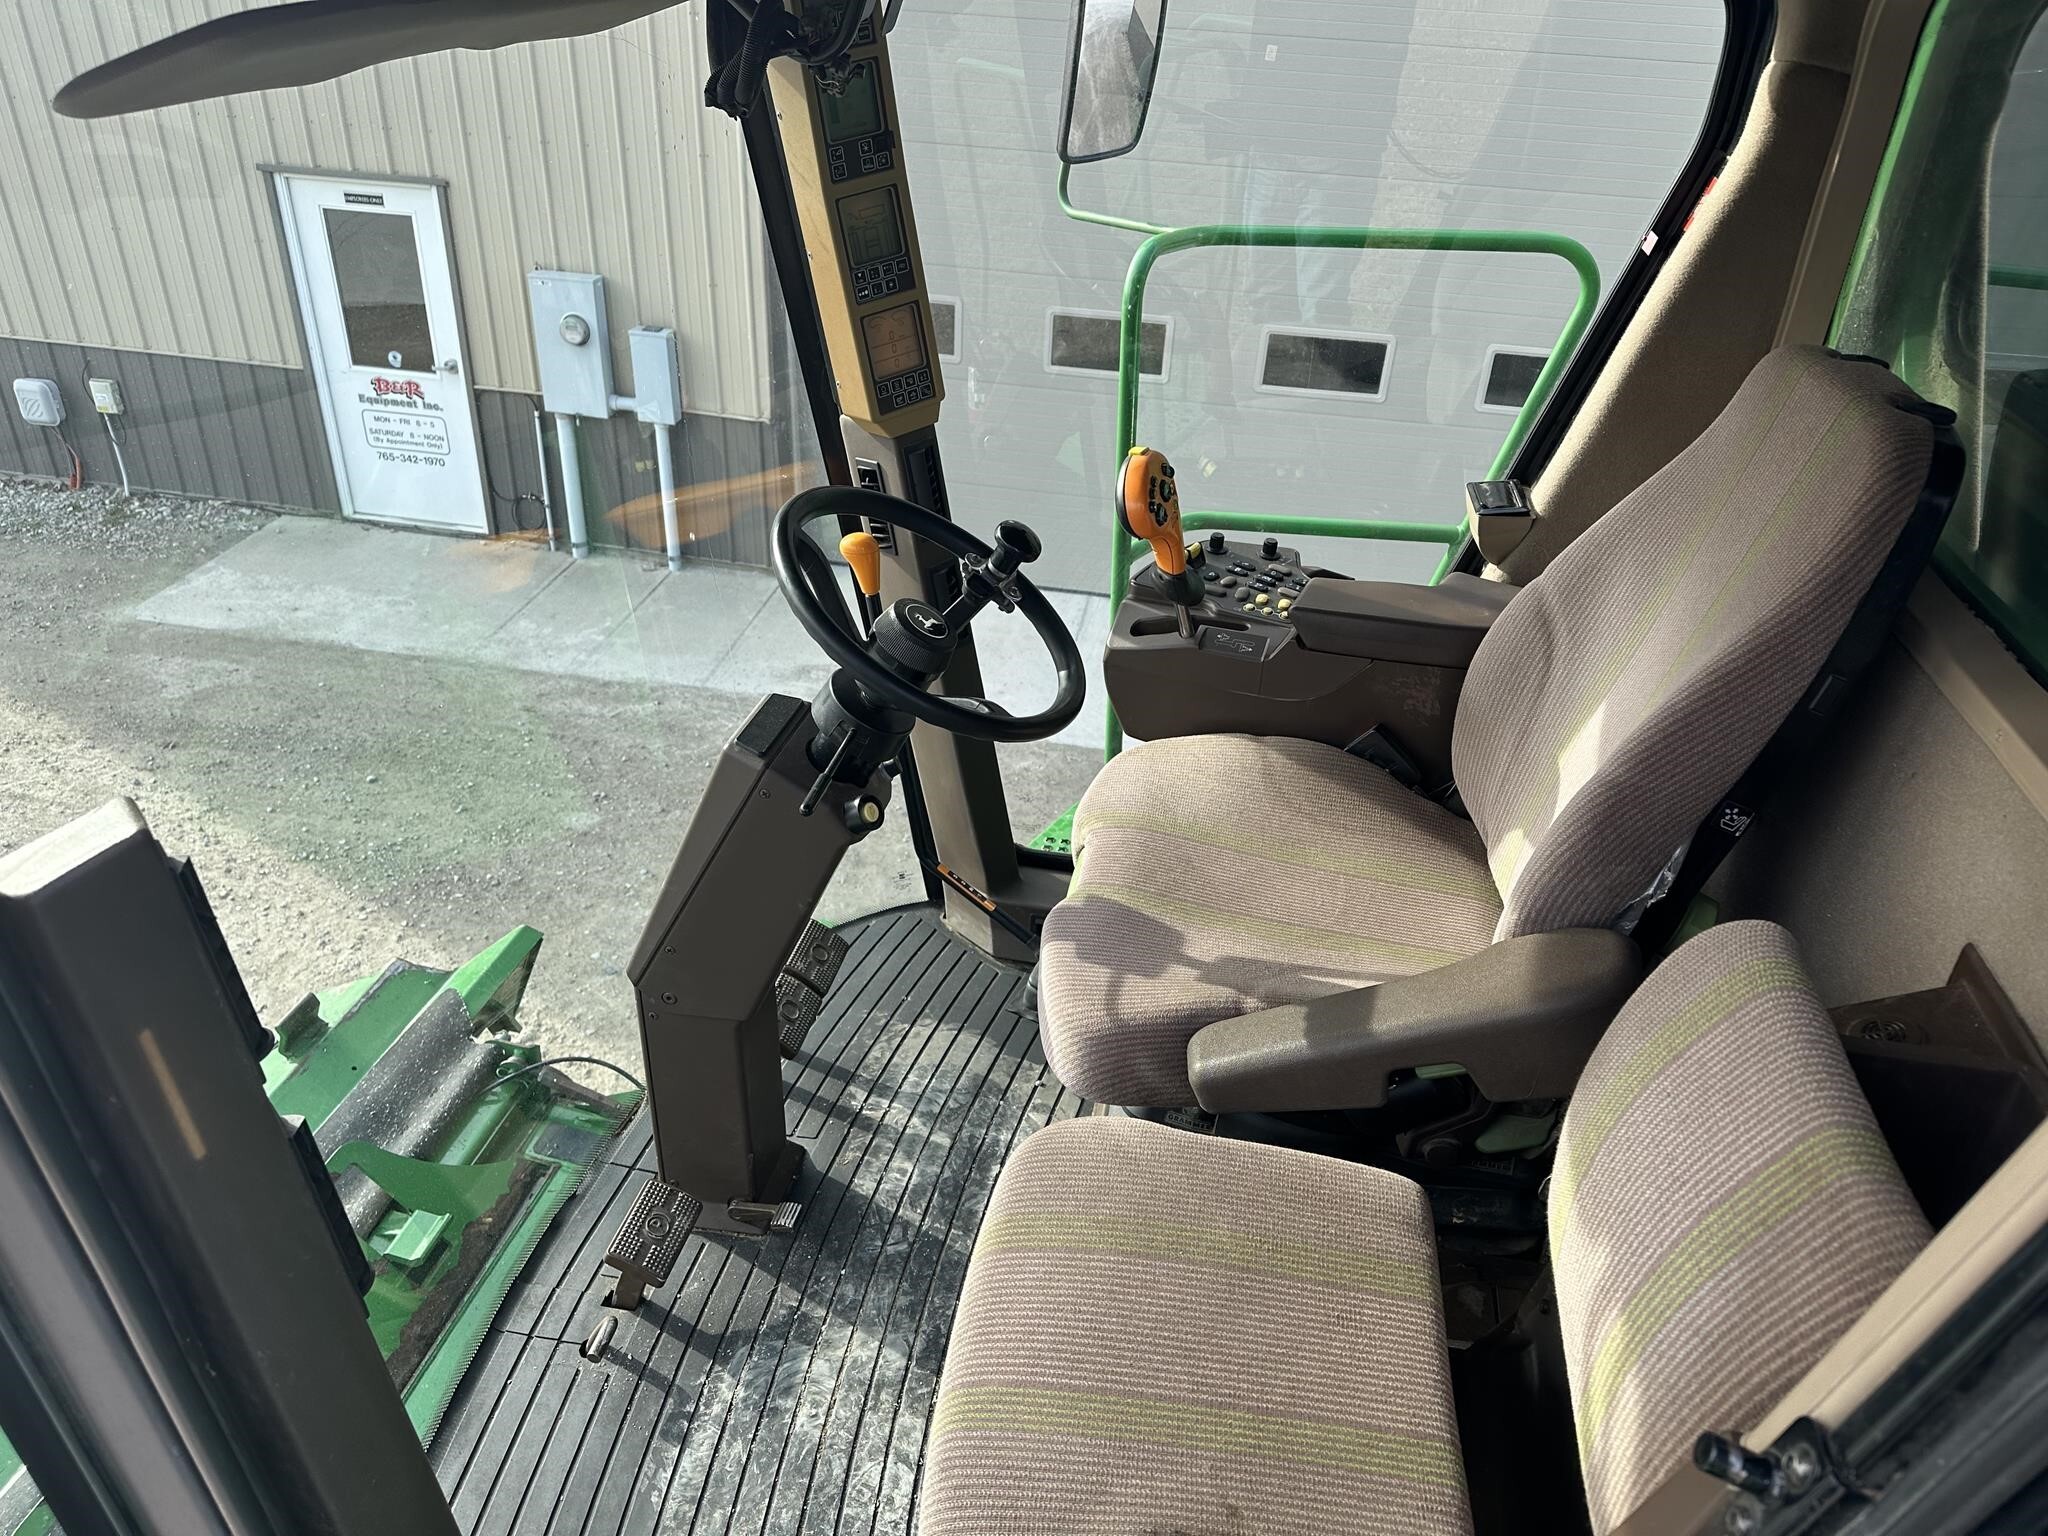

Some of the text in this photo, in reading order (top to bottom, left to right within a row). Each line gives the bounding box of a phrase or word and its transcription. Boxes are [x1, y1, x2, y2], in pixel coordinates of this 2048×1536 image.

[371, 376, 424, 400] B&R
[358, 393, 444, 412] Equipment Inc.
[373, 415, 391, 423] MON
[369, 428, 404, 437] SATURDAY
[423, 433, 445, 442] NOON
[386, 437, 424, 447] Appointment
[377, 451, 446, 467] 765-342-1970
